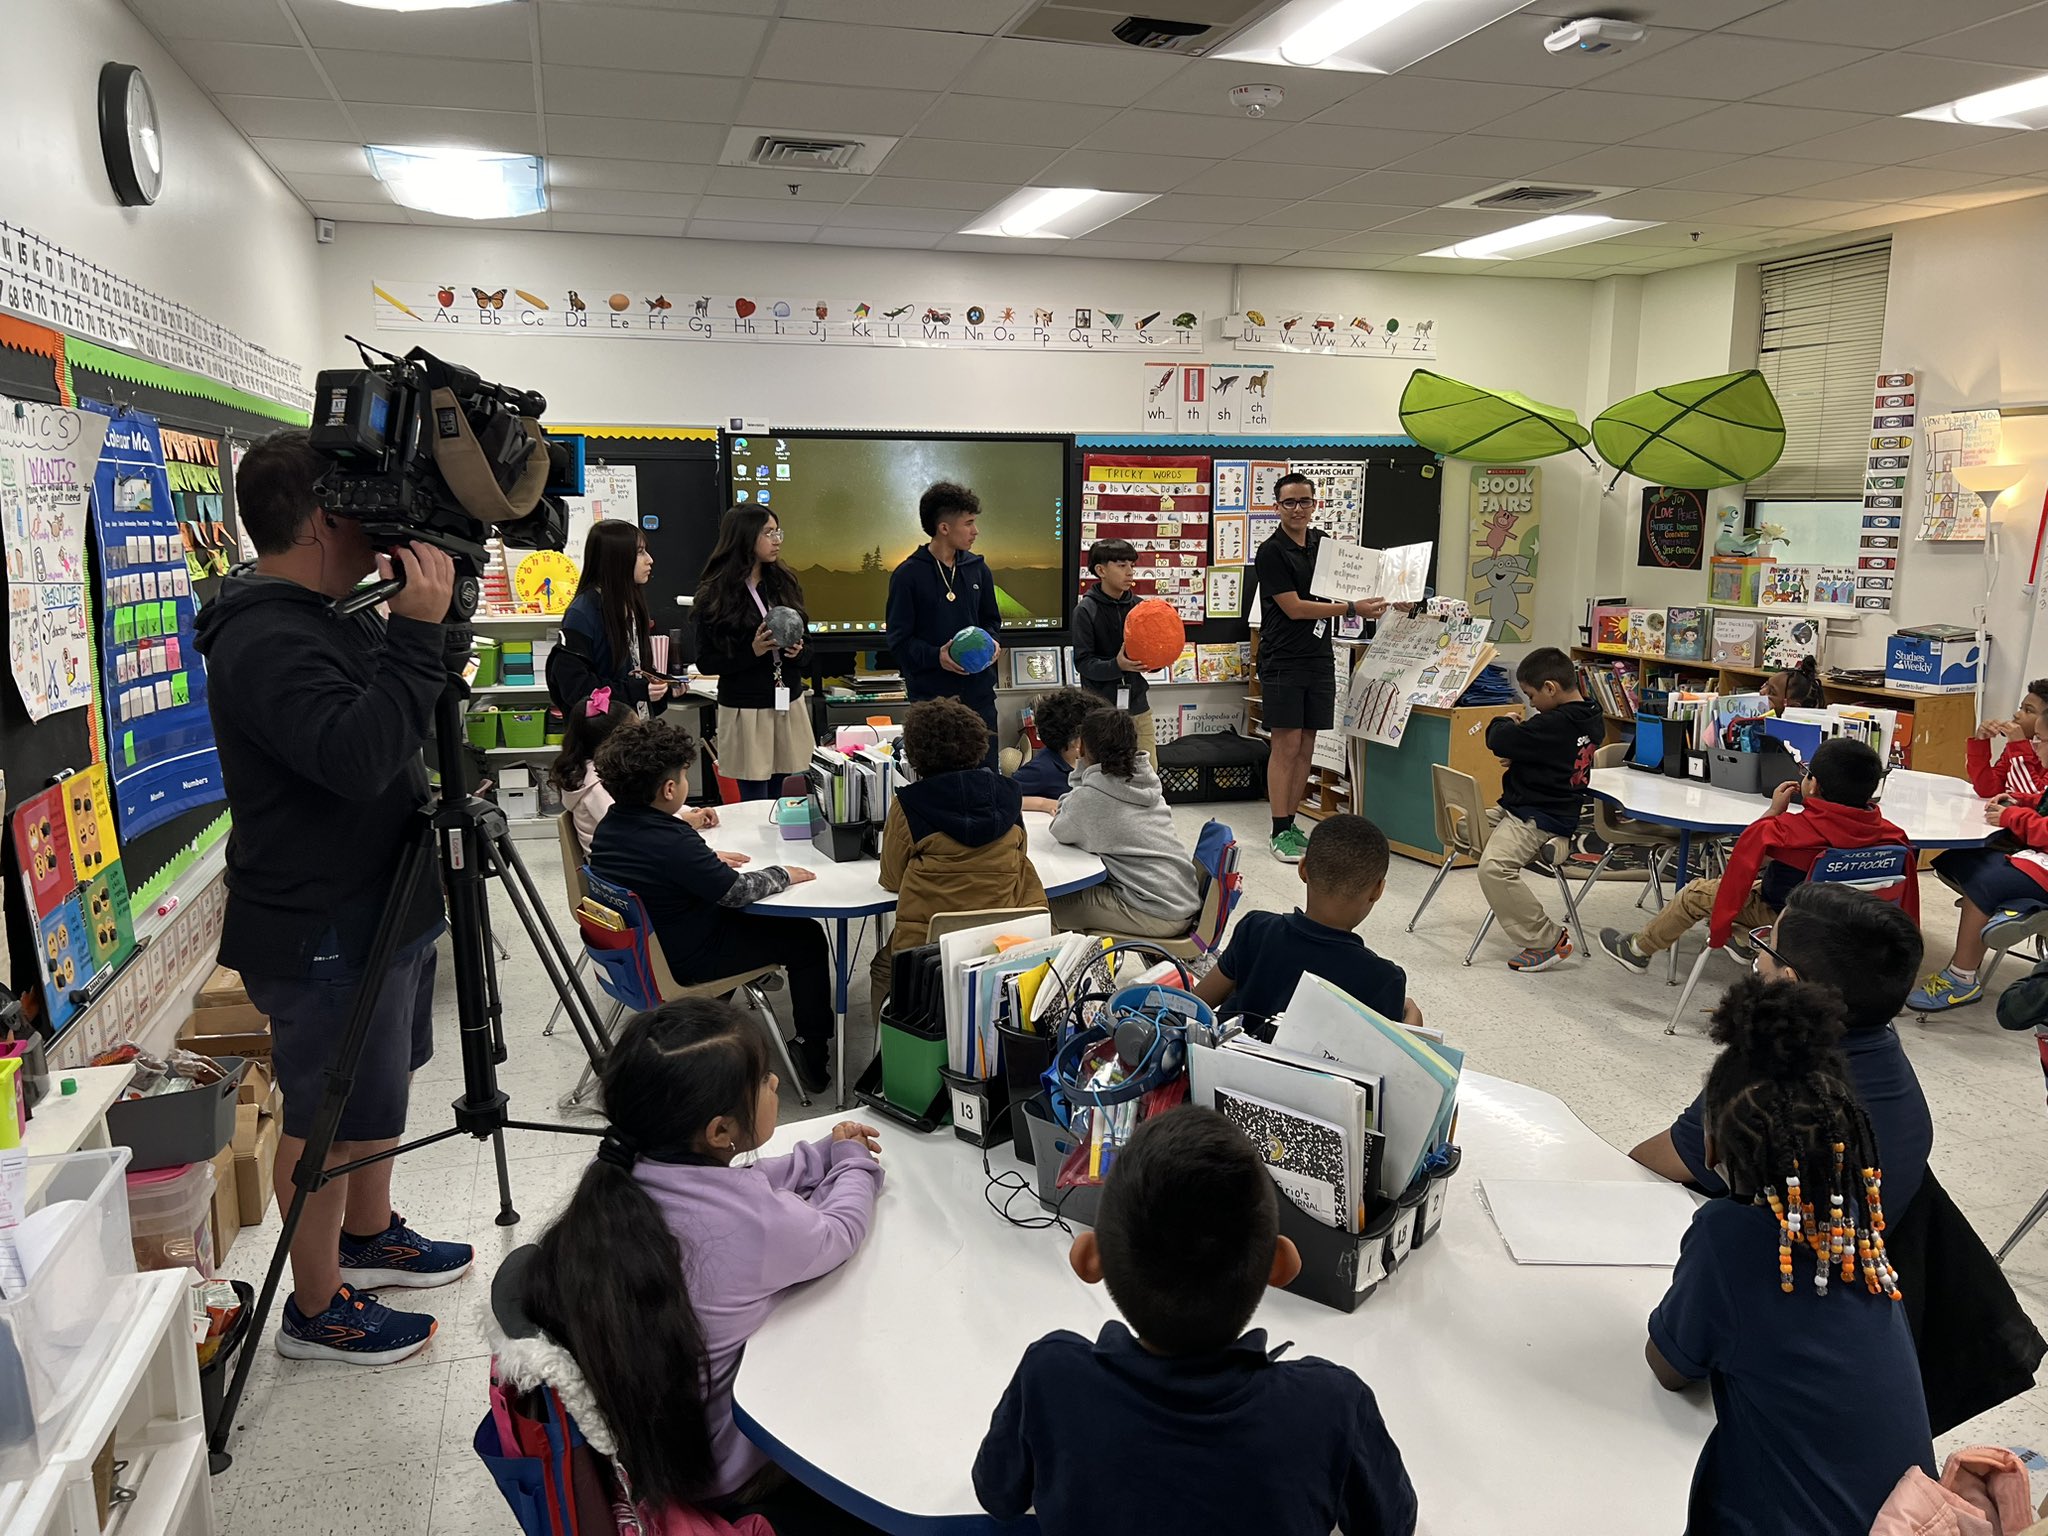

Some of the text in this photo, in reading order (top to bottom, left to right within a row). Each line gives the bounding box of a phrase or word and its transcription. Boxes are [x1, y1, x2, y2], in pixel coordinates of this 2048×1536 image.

[18, 242, 150, 320] 15 16 17 18 19 20 21 22 23 24 25 26
[9, 284, 118, 342] 68 69 70 71 72 73 74 75 76
[434, 310, 1192, 348] Aa Bb Cc Dd Ee Ff Gg Hh Ii Jj Kk Ll Mm Nn Oo Pp Qq Rr Ss Tt
[1244, 328, 1428, 355] Uu Vv Ww Xx Yy Zz
[1187, 408, 1200, 420] th
[1217, 408, 1232, 420] sh
[1250, 403, 1263, 413] ch
[1924, 416, 1940, 427] How
[1926, 434, 1934, 452] 1
[1926, 453, 1934, 472] 2
[29, 457, 76, 484] WANTS
[1105, 468, 1182, 479] TRICKY WORDS
[84, 483, 92, 492] to
[1110, 484, 1118, 492] Bb
[1134, 485, 1144, 493] Cc
[1478, 477, 1533, 494] BOOK
[1926, 473, 1934, 494] 3
[65, 492, 80, 502] need
[1084, 496, 1095, 505] all
[1479, 496, 1532, 513] FAIRS
[1925, 494, 1932, 516] 4
[1108, 513, 1119, 522] Gg
[1134, 512, 1142, 520] Hh
[1184, 512, 1190, 522] Jj
[1654, 505, 1698, 521] LOVE PEACE
[1160, 526, 1167, 535] I
[1650, 520, 1674, 531] PATIENCE
[1923, 516, 1931, 538] 5
[1180, 540, 1190, 549] Oo
[1338, 548, 1354, 561] How
[1342, 562, 1362, 571] solar
[1778, 574, 1797, 582] ZOO
[1191, 580, 1202, 590] to
[1336, 580, 1371, 594] happen?
[1180, 596, 1186, 604] Yy
[52, 626, 68, 638] doctor
[1895, 650, 1926, 662] Studies
[1903, 660, 1932, 674] Weekly
[1726, 699, 1746, 714] Only
[1186, 712, 1230, 721] Encyclopedia
[1194, 722, 1226, 733] Places
[1694, 762, 1698, 770] 7
[182, 778, 208, 790] Numbers
[1826, 857, 1897, 873] SEAT POCKET
[107, 1004, 112, 1016] 7
[69, 1047, 74, 1060] 5
[961, 1102, 974, 1120] 13
[1432, 1194, 1440, 1213] 2
[1397, 1224, 1408, 1246] 18
[1366, 1254, 1372, 1274] 1
